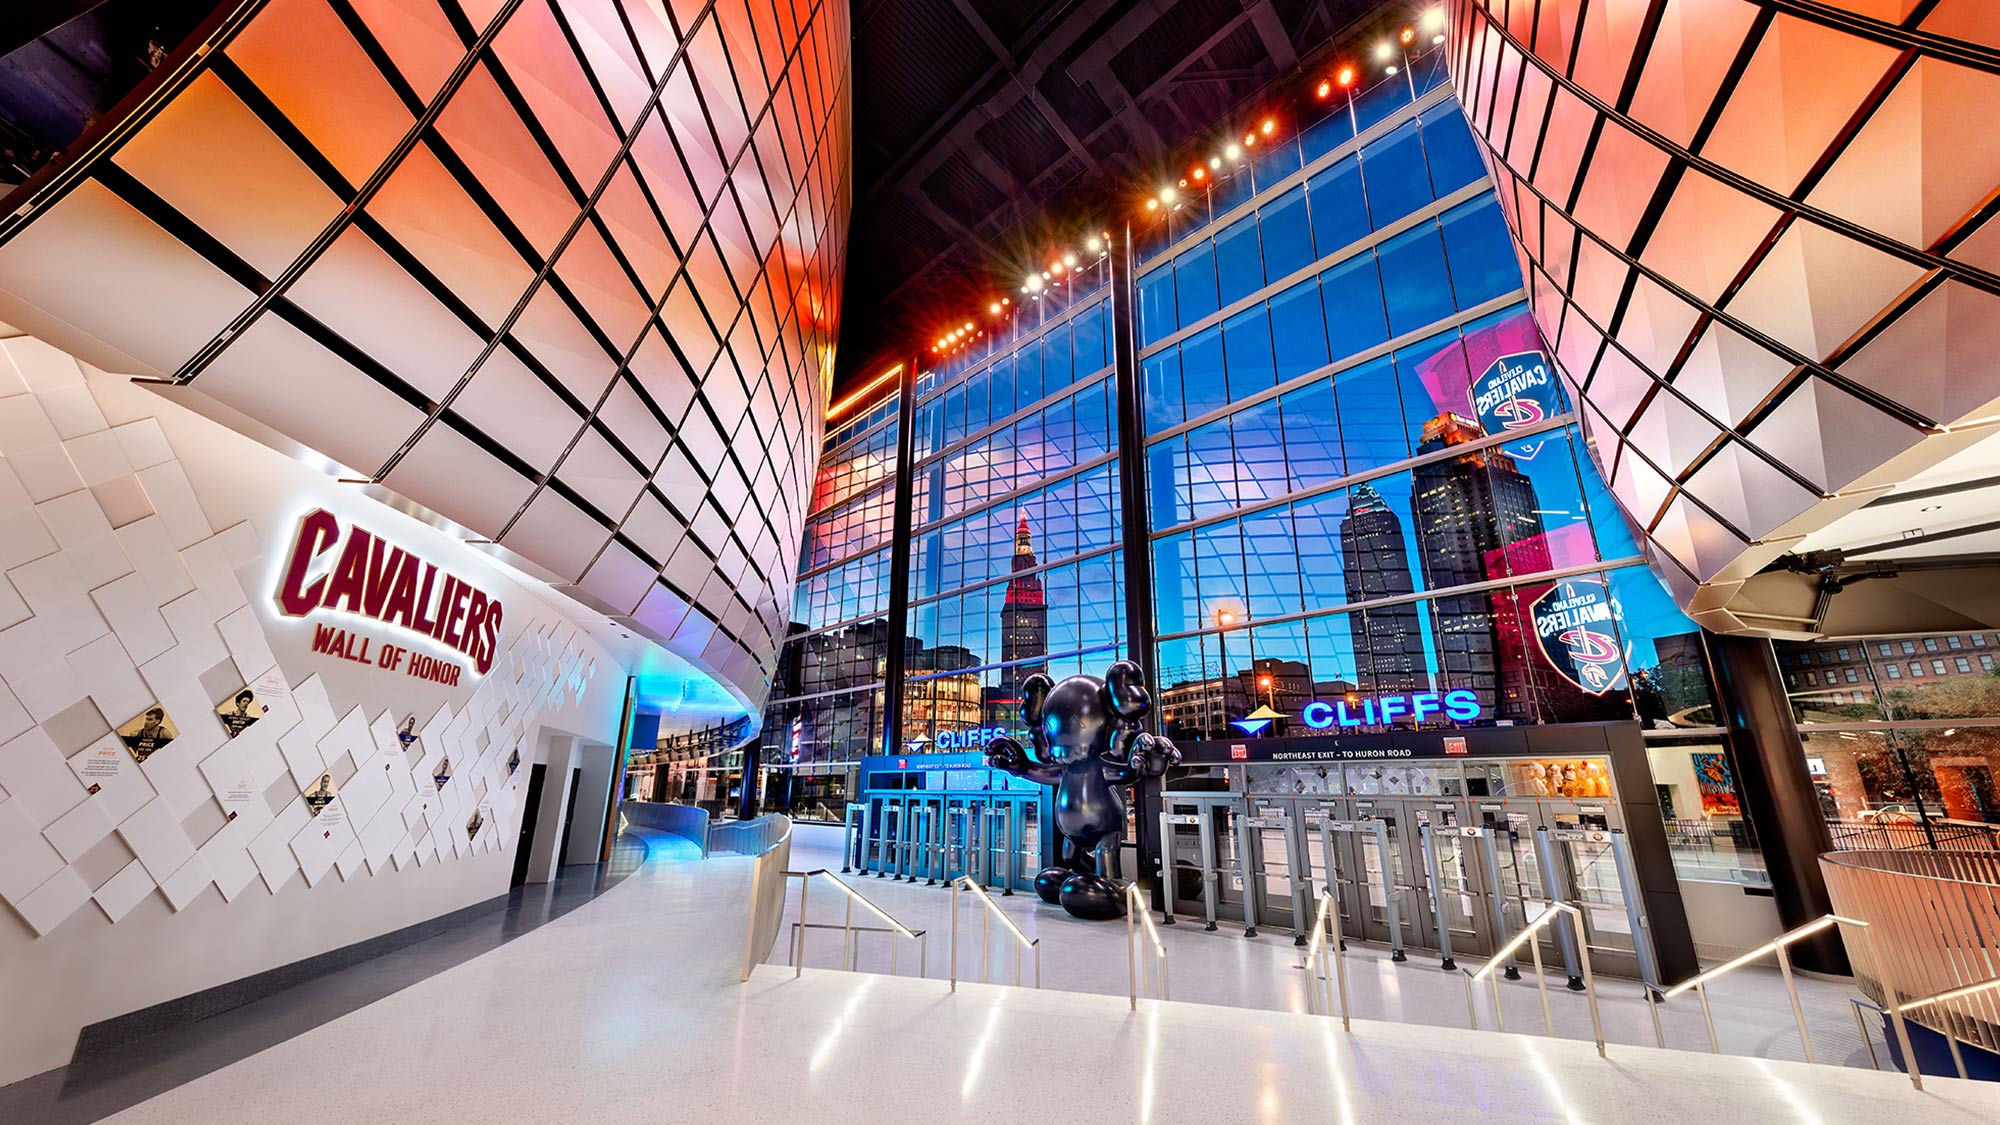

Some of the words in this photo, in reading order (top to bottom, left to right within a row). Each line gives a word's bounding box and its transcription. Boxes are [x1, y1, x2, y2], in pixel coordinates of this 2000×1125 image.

[274, 507, 503, 676] CAVALIERS
[311, 622, 372, 665] WALL
[378, 643, 407, 671] OF
[406, 652, 461, 687] HONOR
[1303, 690, 1481, 729] CLIFFS
[1272, 752, 1316, 760] NORTHEAST
[1318, 751, 1335, 760] EXIT
[1342, 751, 1354, 759] TO
[1355, 750, 1386, 758] HURON
[1387, 749, 1412, 758] ROAD
